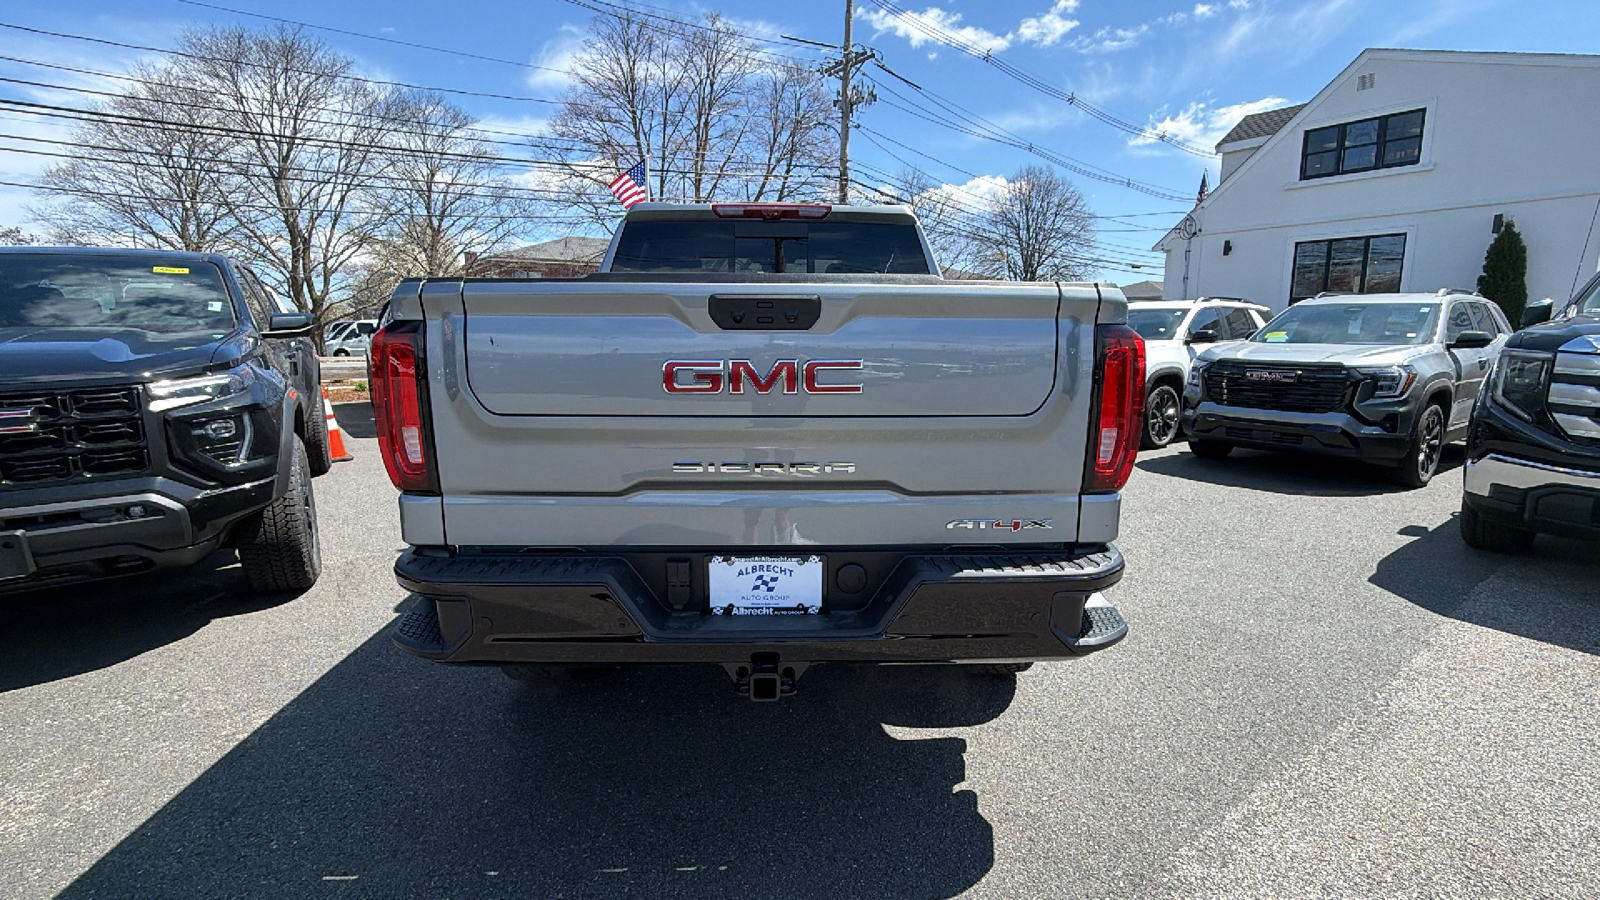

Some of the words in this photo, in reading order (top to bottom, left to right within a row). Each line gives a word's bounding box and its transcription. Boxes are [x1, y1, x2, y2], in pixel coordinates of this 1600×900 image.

[662, 358, 864, 395] GMC
[1246, 371, 1295, 382] GMC
[672, 460, 856, 474] SIERRA
[946, 518, 1054, 533] AT4X
[737, 565, 793, 577] ALBRECHT
[731, 607, 774, 616] Albrecht
